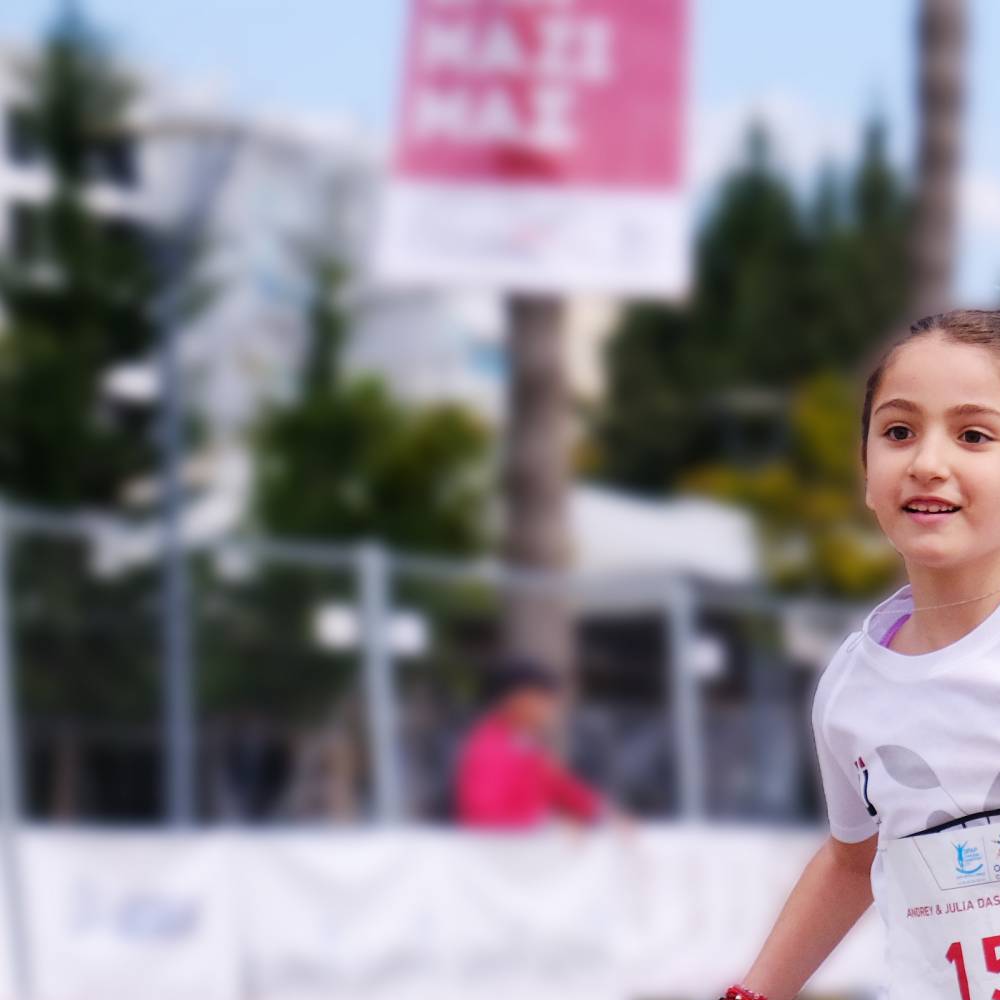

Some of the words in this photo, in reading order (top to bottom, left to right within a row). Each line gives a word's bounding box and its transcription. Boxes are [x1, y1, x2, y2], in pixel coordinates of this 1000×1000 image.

[906, 905, 934, 918] ANDREY
[935, 903, 943, 915] &
[944, 900, 975, 915] JULIA
